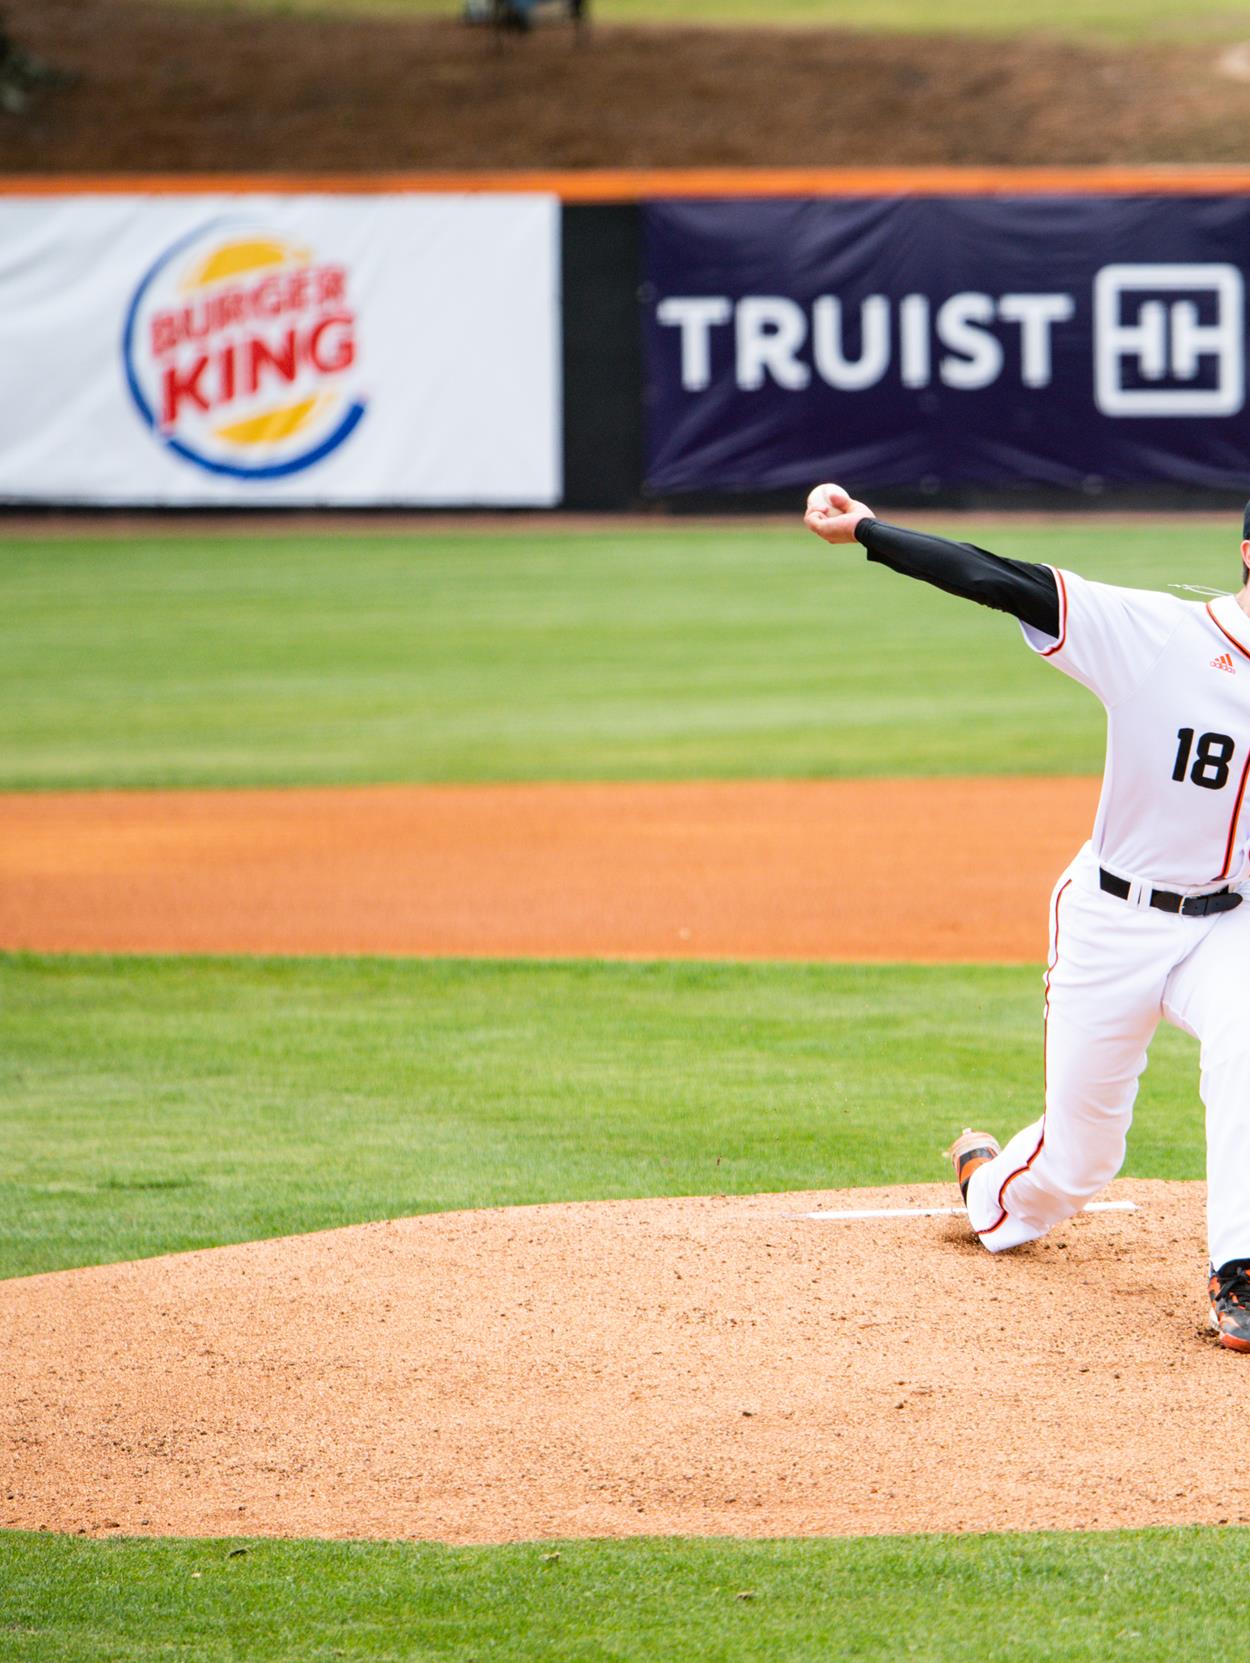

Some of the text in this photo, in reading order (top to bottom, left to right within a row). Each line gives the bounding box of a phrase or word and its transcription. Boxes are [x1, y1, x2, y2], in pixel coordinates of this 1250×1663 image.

[151, 264, 348, 358] BURGER
[656, 292, 1075, 391] TRUIST
[163, 312, 356, 436] KING
[1172, 727, 1235, 790] 18
